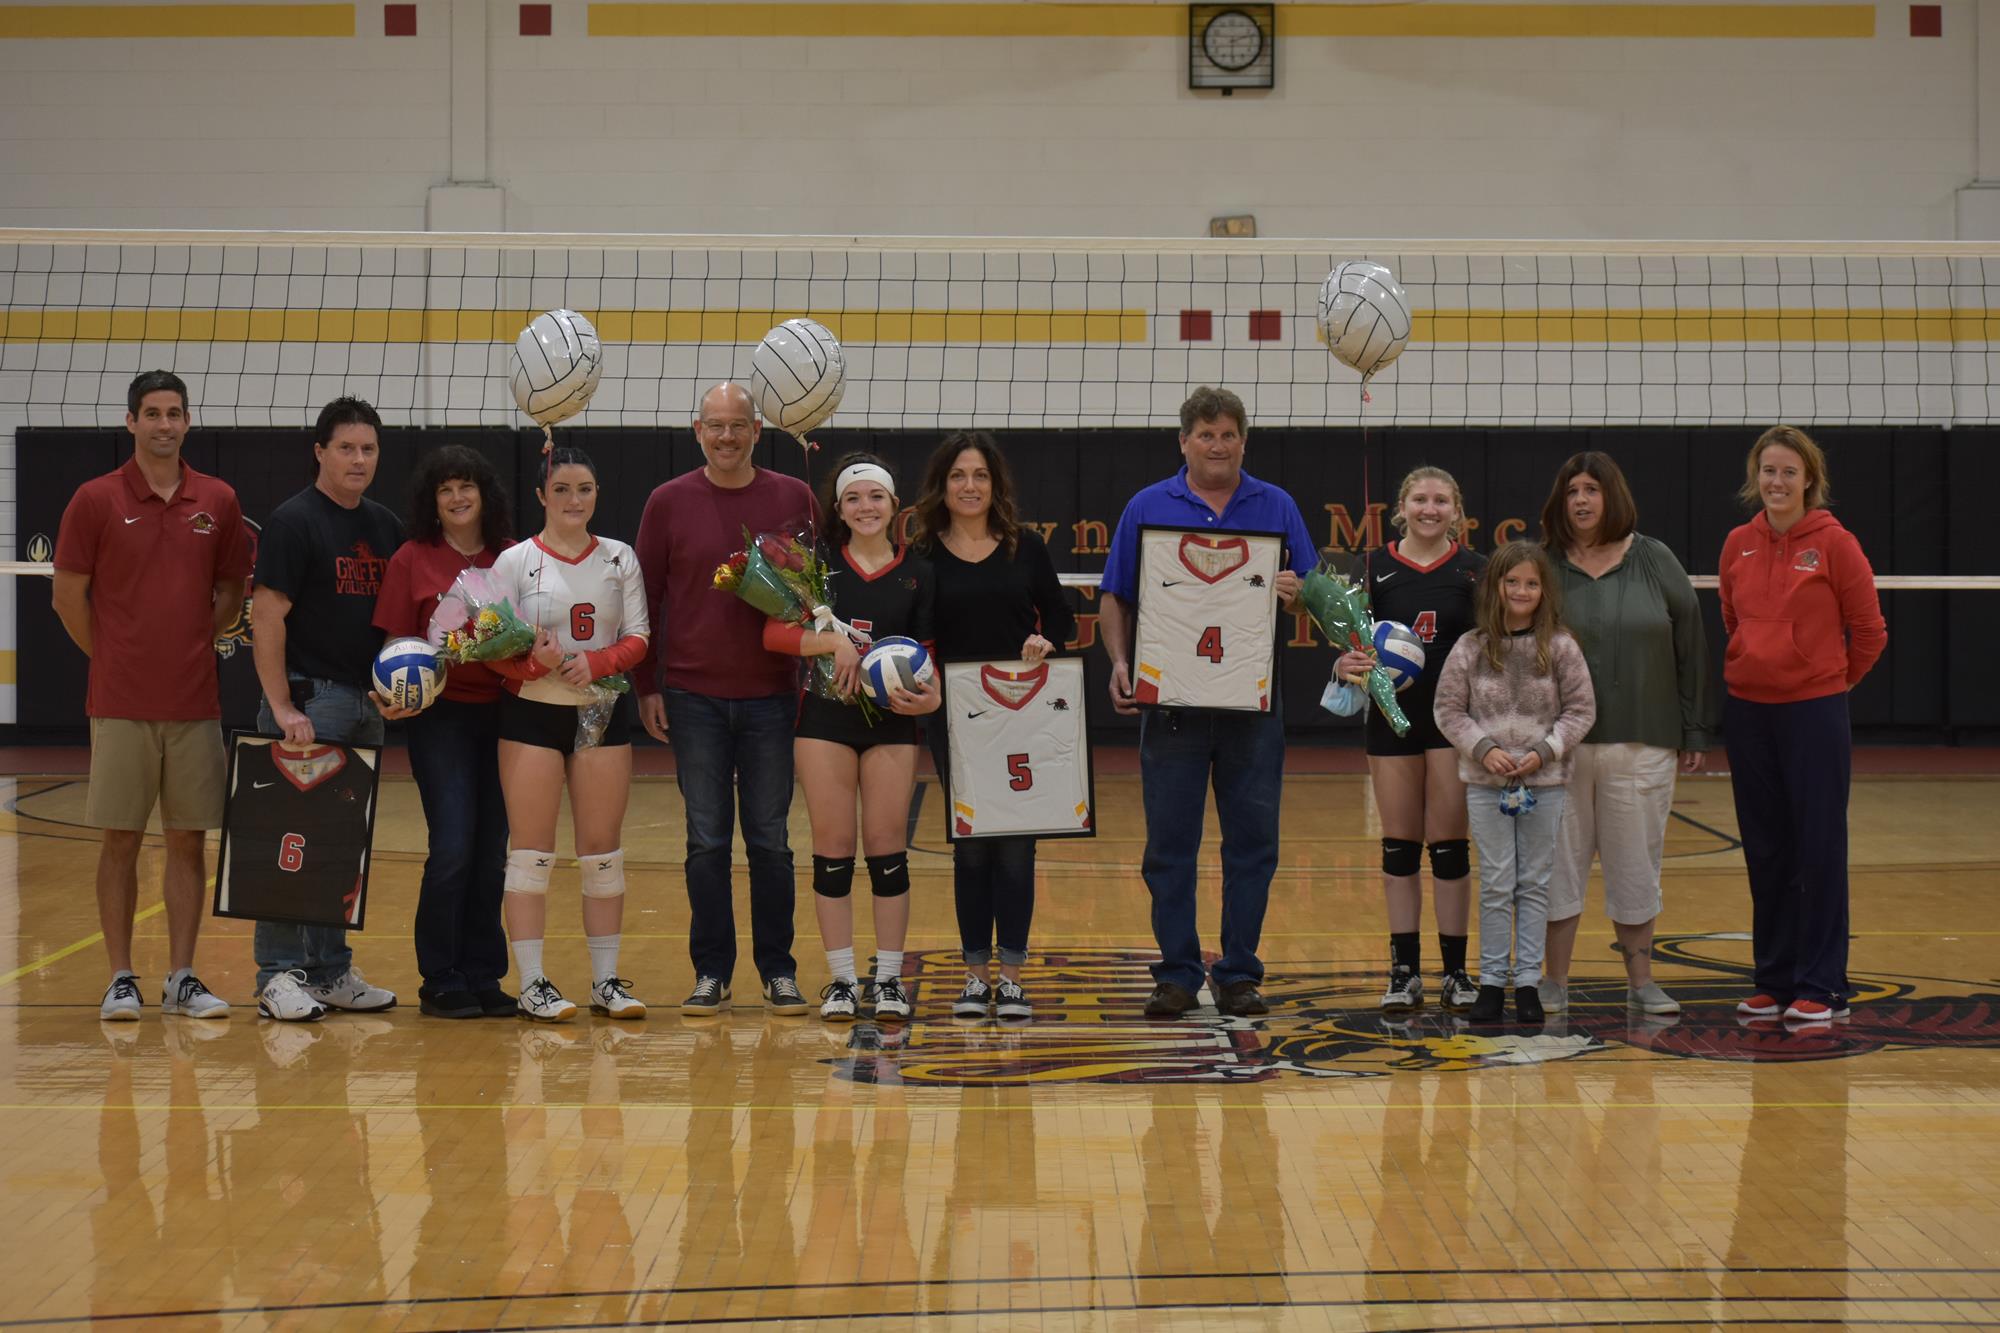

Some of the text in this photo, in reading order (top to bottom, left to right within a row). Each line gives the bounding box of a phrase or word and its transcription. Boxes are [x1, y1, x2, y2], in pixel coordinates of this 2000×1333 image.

[335, 556, 389, 580] GRIFFI
[570, 602, 595, 641] 6
[1411, 610, 1438, 643] 4
[1197, 626, 1224, 663] 4
[1007, 753, 1033, 792] 5
[278, 832, 306, 872] 6
